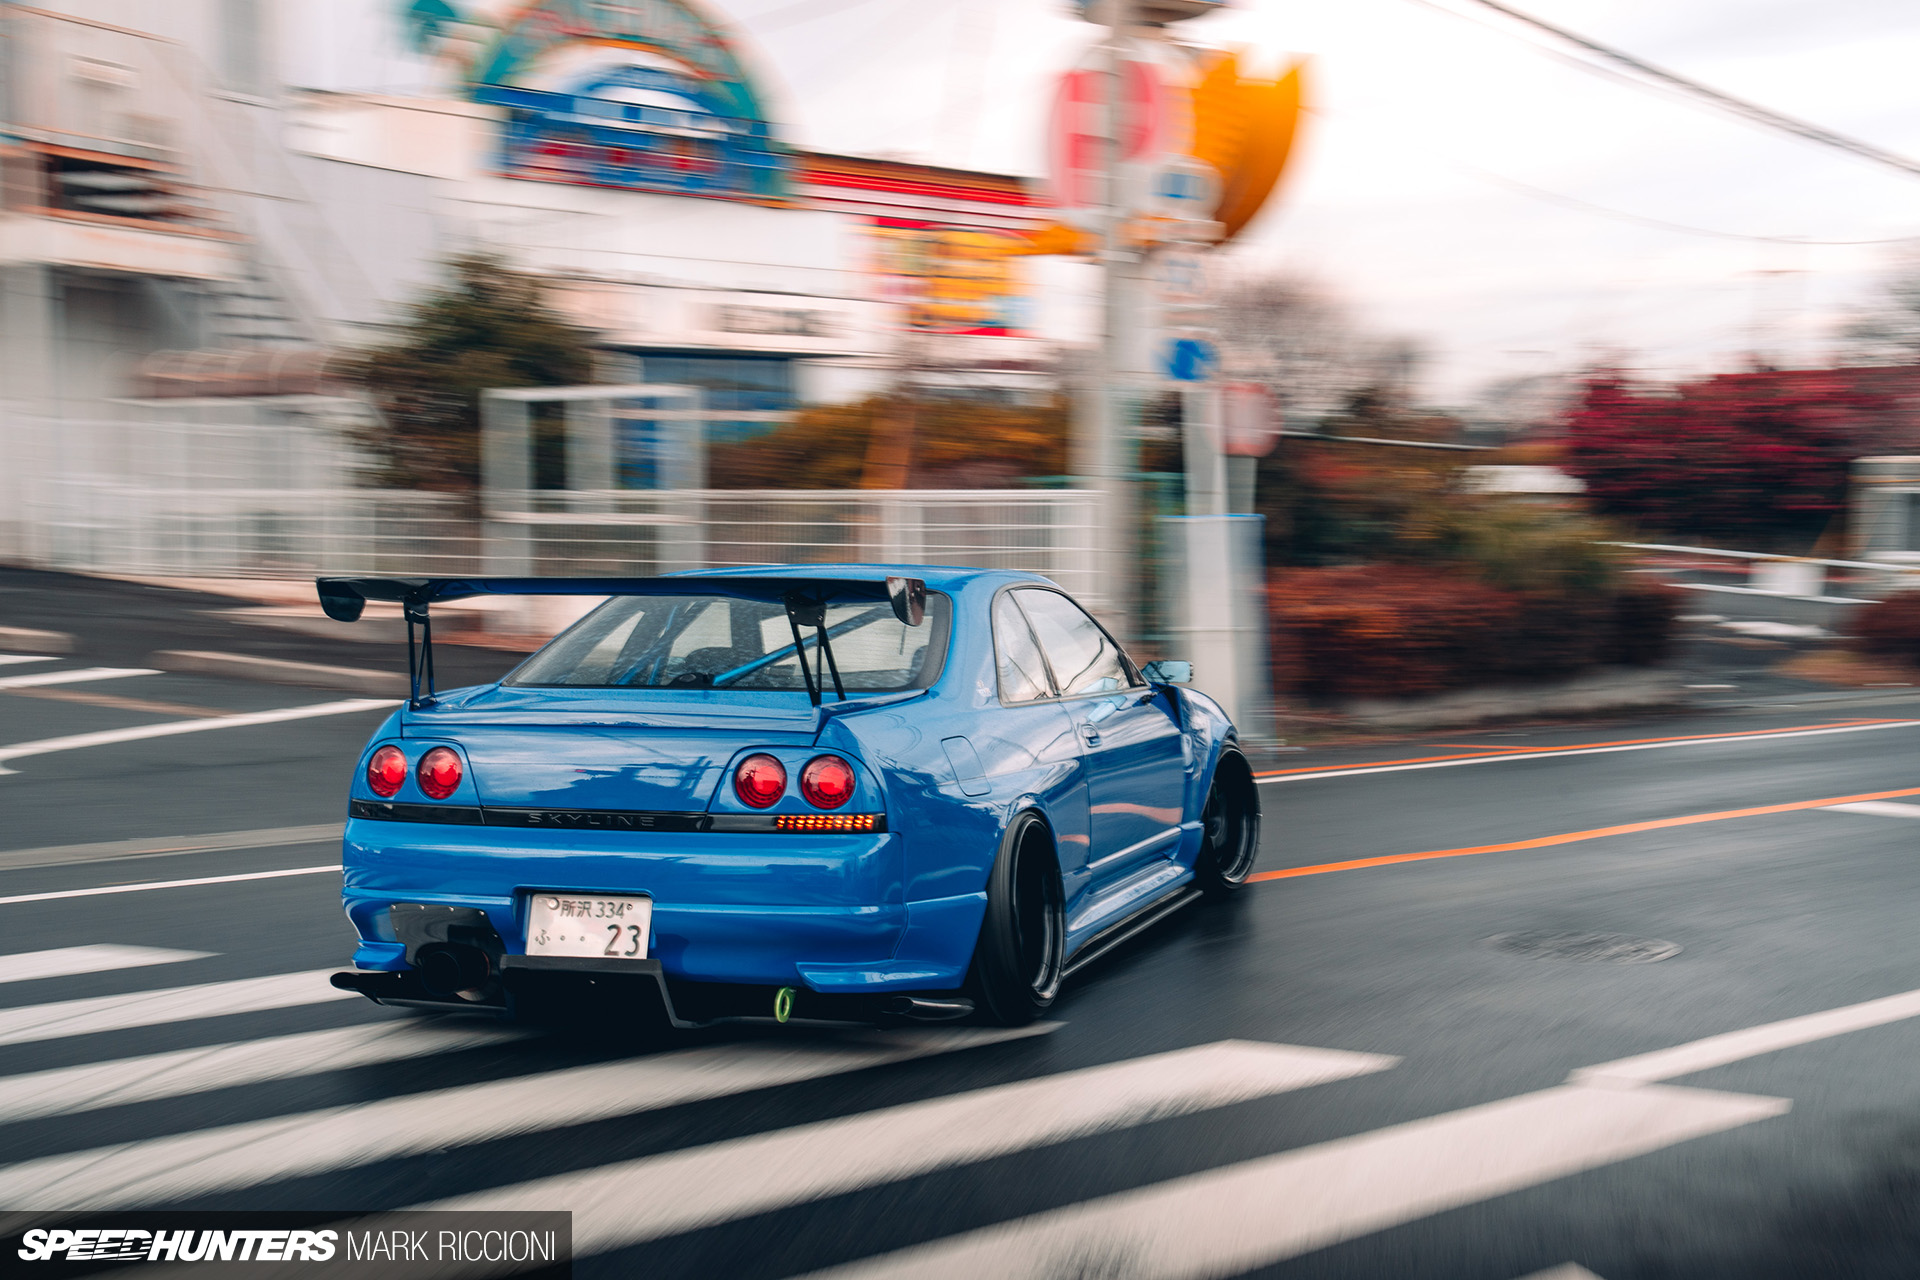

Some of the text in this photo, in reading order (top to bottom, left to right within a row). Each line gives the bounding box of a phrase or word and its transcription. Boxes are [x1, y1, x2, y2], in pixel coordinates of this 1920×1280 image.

[528, 813, 655, 827] SKYLINE
[560, 900, 625, 919] 所沢 334
[603, 924, 642, 957] 23
